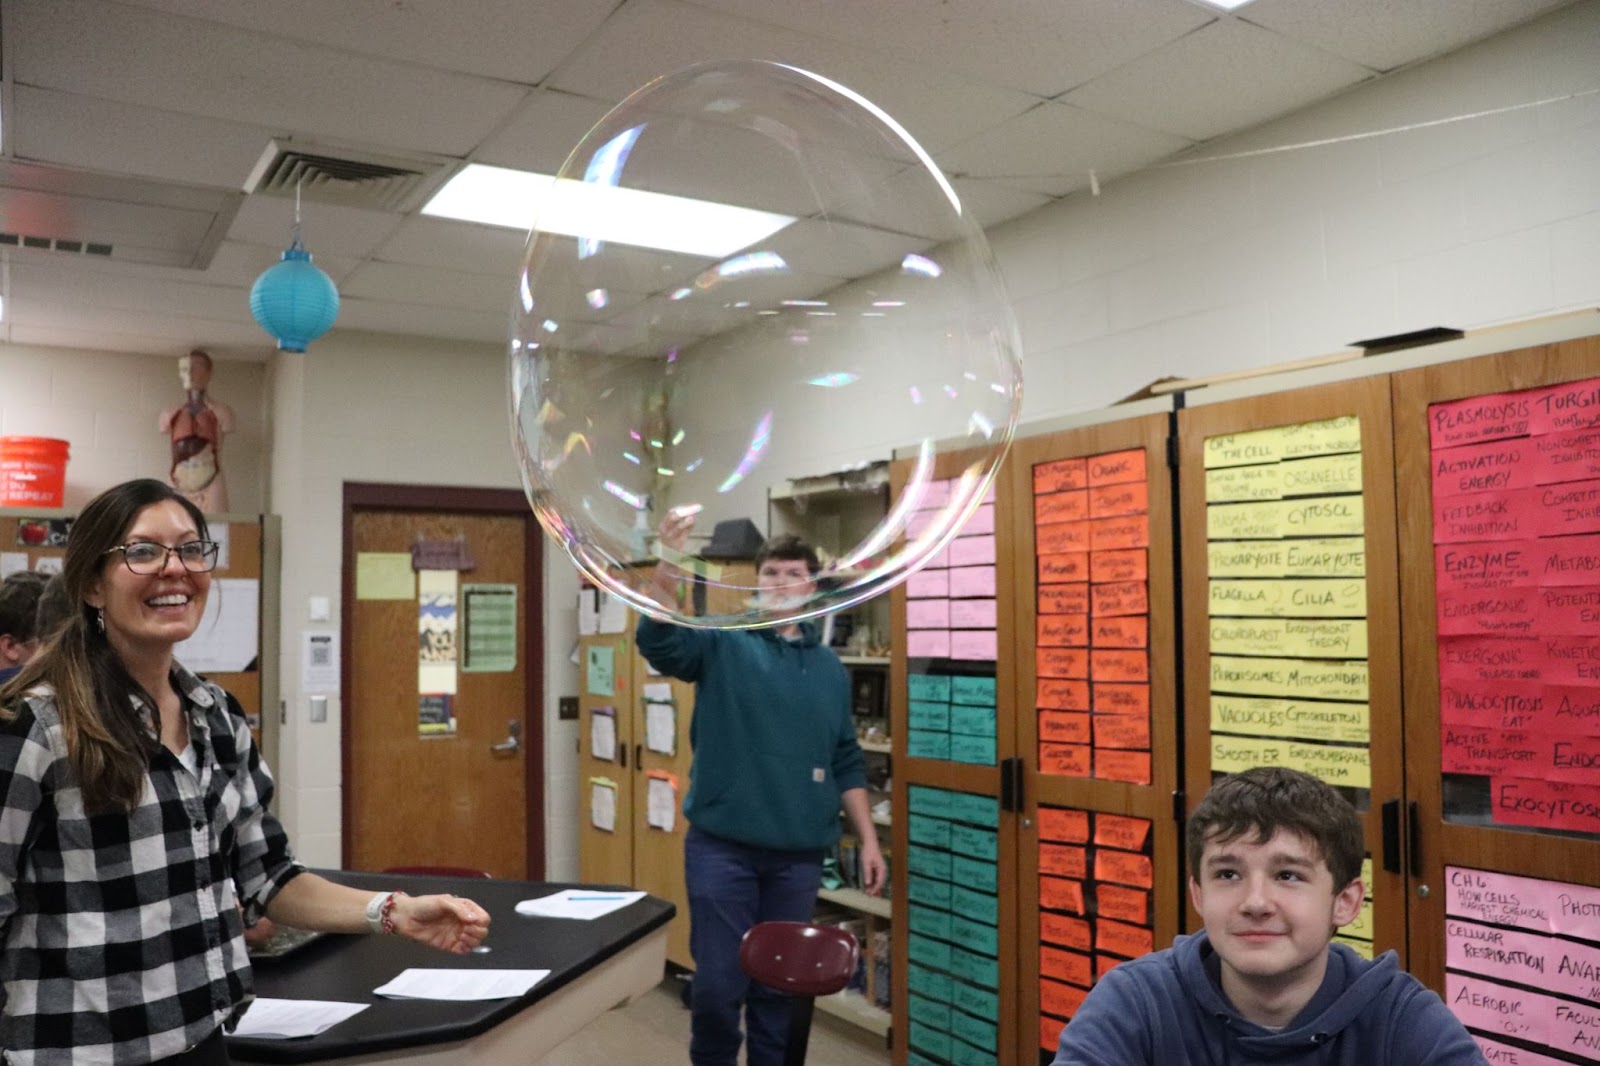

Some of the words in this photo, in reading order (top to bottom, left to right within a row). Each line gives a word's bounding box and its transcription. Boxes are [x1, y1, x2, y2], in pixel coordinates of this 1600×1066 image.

[1435, 401, 1529, 432] PLASMOLYSIS
[1437, 451, 1520, 476] ACTIVATION
[1459, 471, 1511, 490] ENERGY
[1442, 500, 1509, 522] FEEDBACK
[1451, 519, 1518, 536] INHIBITION
[1287, 547, 1365, 572] EUKARYOTE
[1444, 552, 1520, 579] ENZYME
[1212, 587, 1266, 602] FLAGELLA
[1292, 589, 1335, 606] CILIA
[1443, 598, 1528, 618] ENDERGONIC
[1307, 638, 1350, 652] THEORY
[1218, 704, 1285, 728] VACUOLES
[1446, 731, 1490, 745] ACTIVE
[1215, 744, 1259, 761] SMOOTH
[1263, 748, 1280, 763] ER
[1465, 746, 1537, 761] TRANSPORT
[1452, 872, 1473, 888] CH
[1476, 876, 1487, 888] 6
[1458, 889, 1481, 902] HOW
[1485, 892, 1520, 906] CELLS
[1502, 905, 1549, 921] CHEMICAL
[1448, 924, 1504, 946] CELLULAR
[1463, 943, 1544, 974] RESPIRATION
[1455, 986, 1524, 1016] AEROBIC
